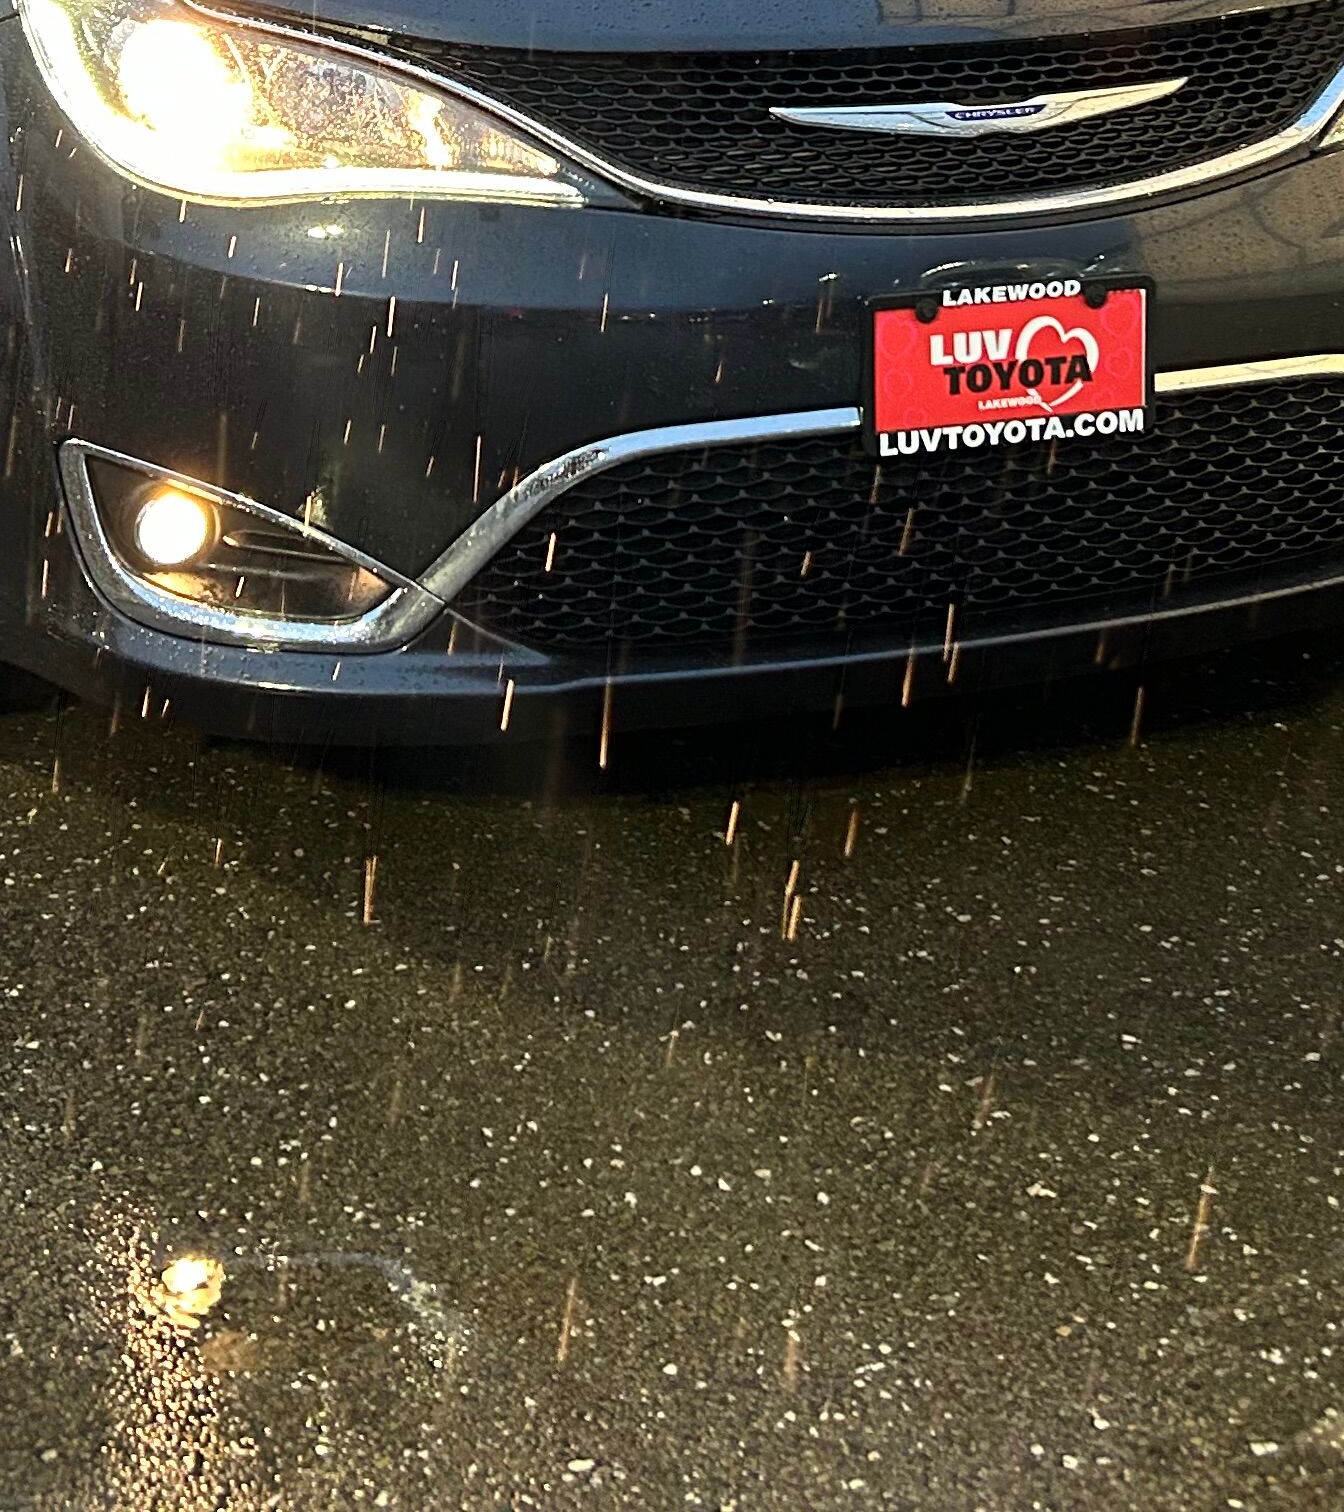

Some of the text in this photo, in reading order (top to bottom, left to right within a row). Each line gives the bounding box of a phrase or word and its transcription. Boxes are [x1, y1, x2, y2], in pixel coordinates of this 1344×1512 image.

[954, 106, 1036, 120] CHRYSLER
[942, 279, 1082, 307] LAKEWOOD
[929, 328, 1013, 366] LUV
[943, 354, 1094, 396] TOYOTA
[977, 395, 1043, 411] LAKEWOOD
[879, 408, 1145, 458] LUVTOYOTA.COM
